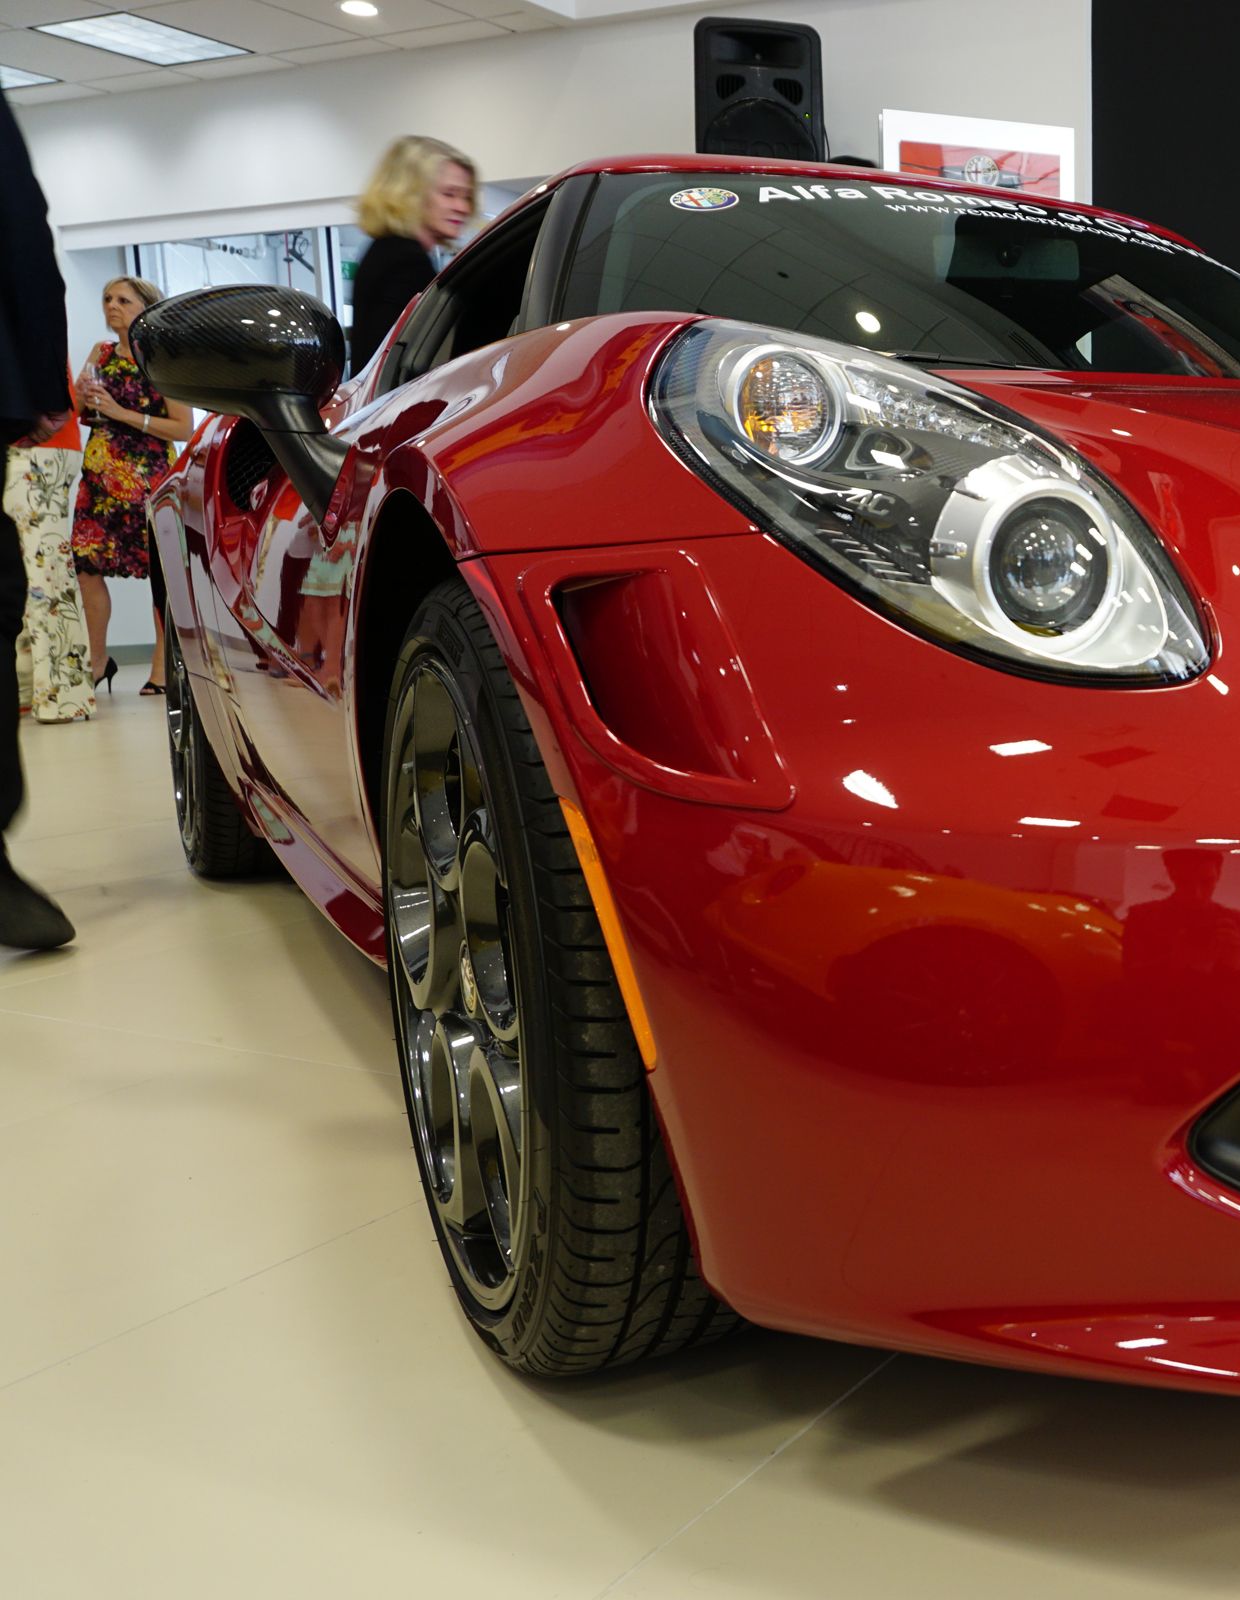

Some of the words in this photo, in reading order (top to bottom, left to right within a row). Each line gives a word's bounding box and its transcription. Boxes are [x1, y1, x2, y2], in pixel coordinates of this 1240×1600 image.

[759, 184, 868, 203] Alfa
[870, 186, 1048, 216] Romeo
[1057, 212, 1093, 225] of
[884, 204, 1176, 254] www.remoferrigroup.com
[846, 487, 896, 516] 4C
